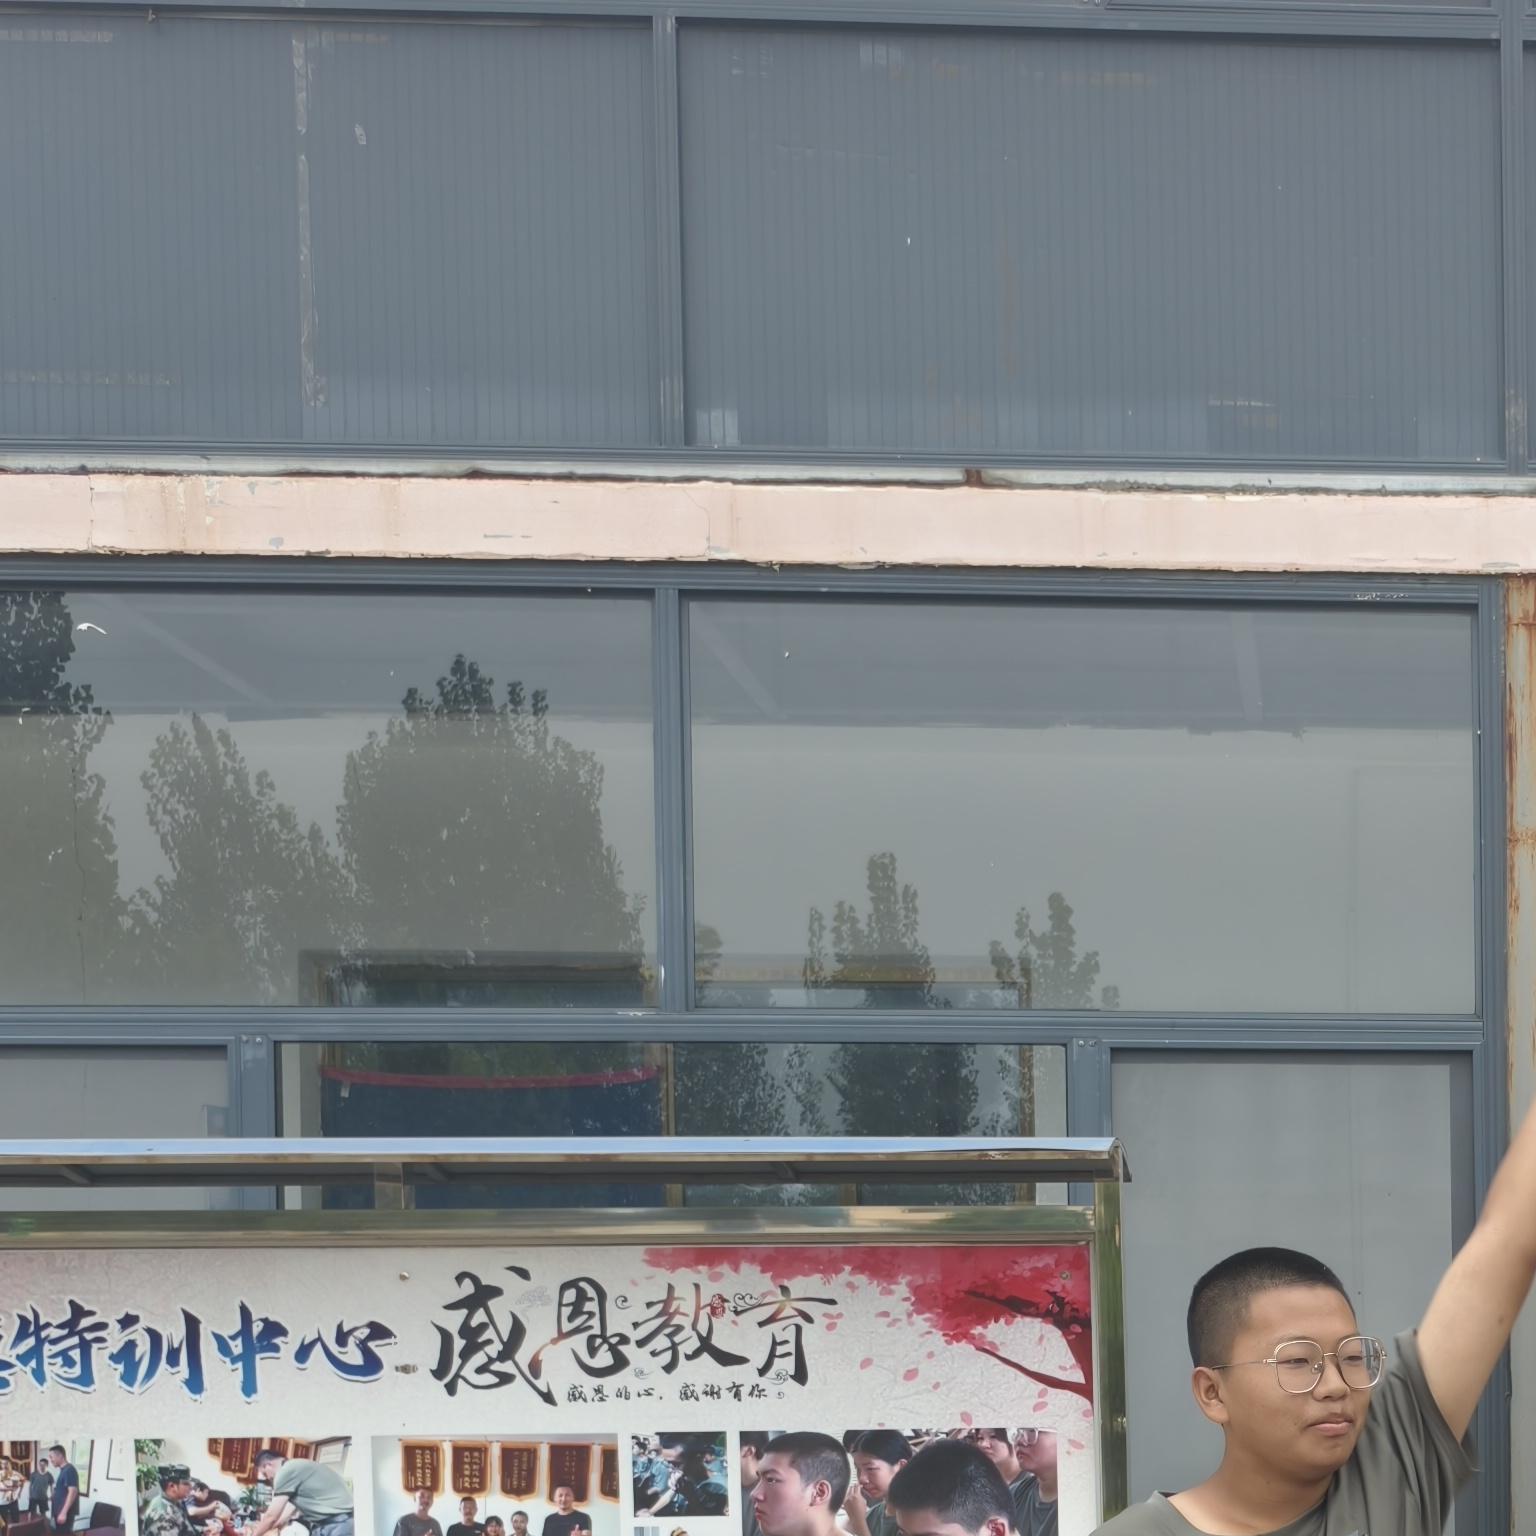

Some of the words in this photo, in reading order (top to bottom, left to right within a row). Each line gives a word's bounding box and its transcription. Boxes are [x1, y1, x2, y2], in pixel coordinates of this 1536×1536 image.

[0, 1297, 398, 1403] 特训中心
[430, 1266, 838, 1406] 感恩教育
